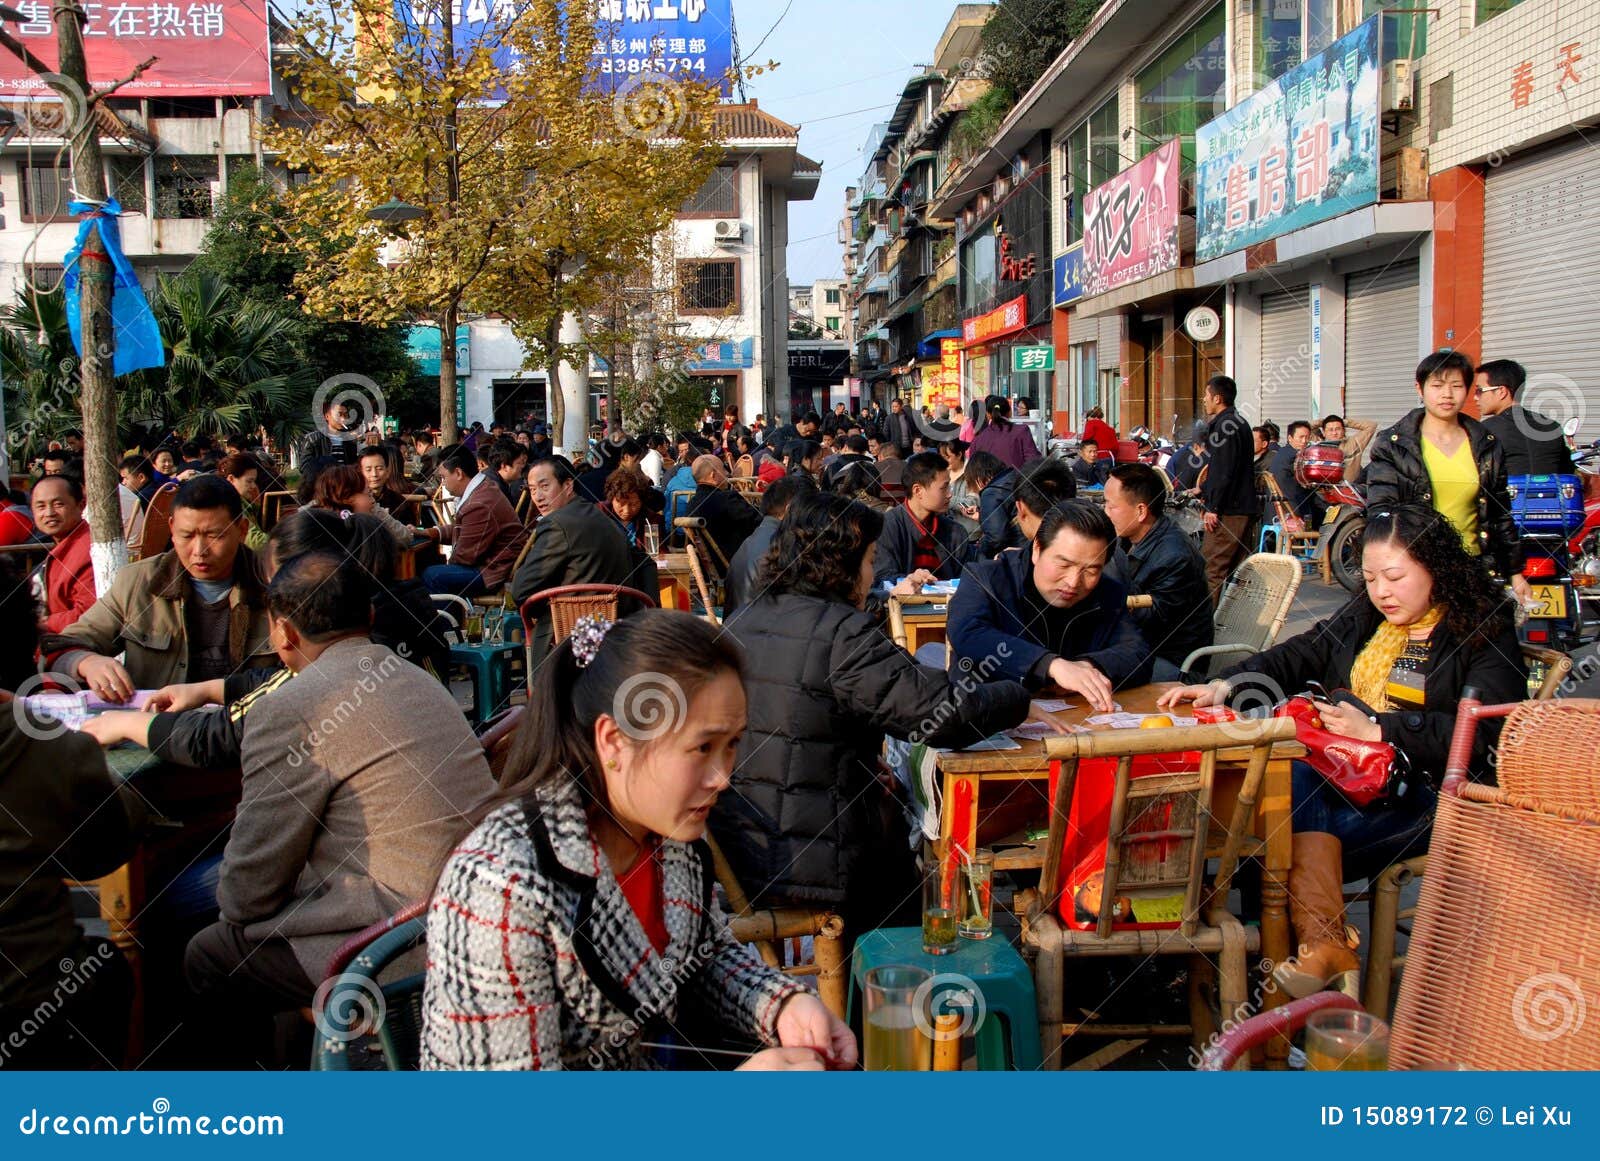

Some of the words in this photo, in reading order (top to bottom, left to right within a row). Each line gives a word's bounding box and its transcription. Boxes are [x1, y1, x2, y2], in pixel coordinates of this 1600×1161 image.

[0, 2, 224, 37] 售正在热销
[1225, 121, 1330, 232] 售房部
[1112, 262, 1146, 282] COFFEE
[1149, 253, 1169, 271] BAR
[1021, 349, 1049, 369] 药
[1539, 586, 1553, 599] A
